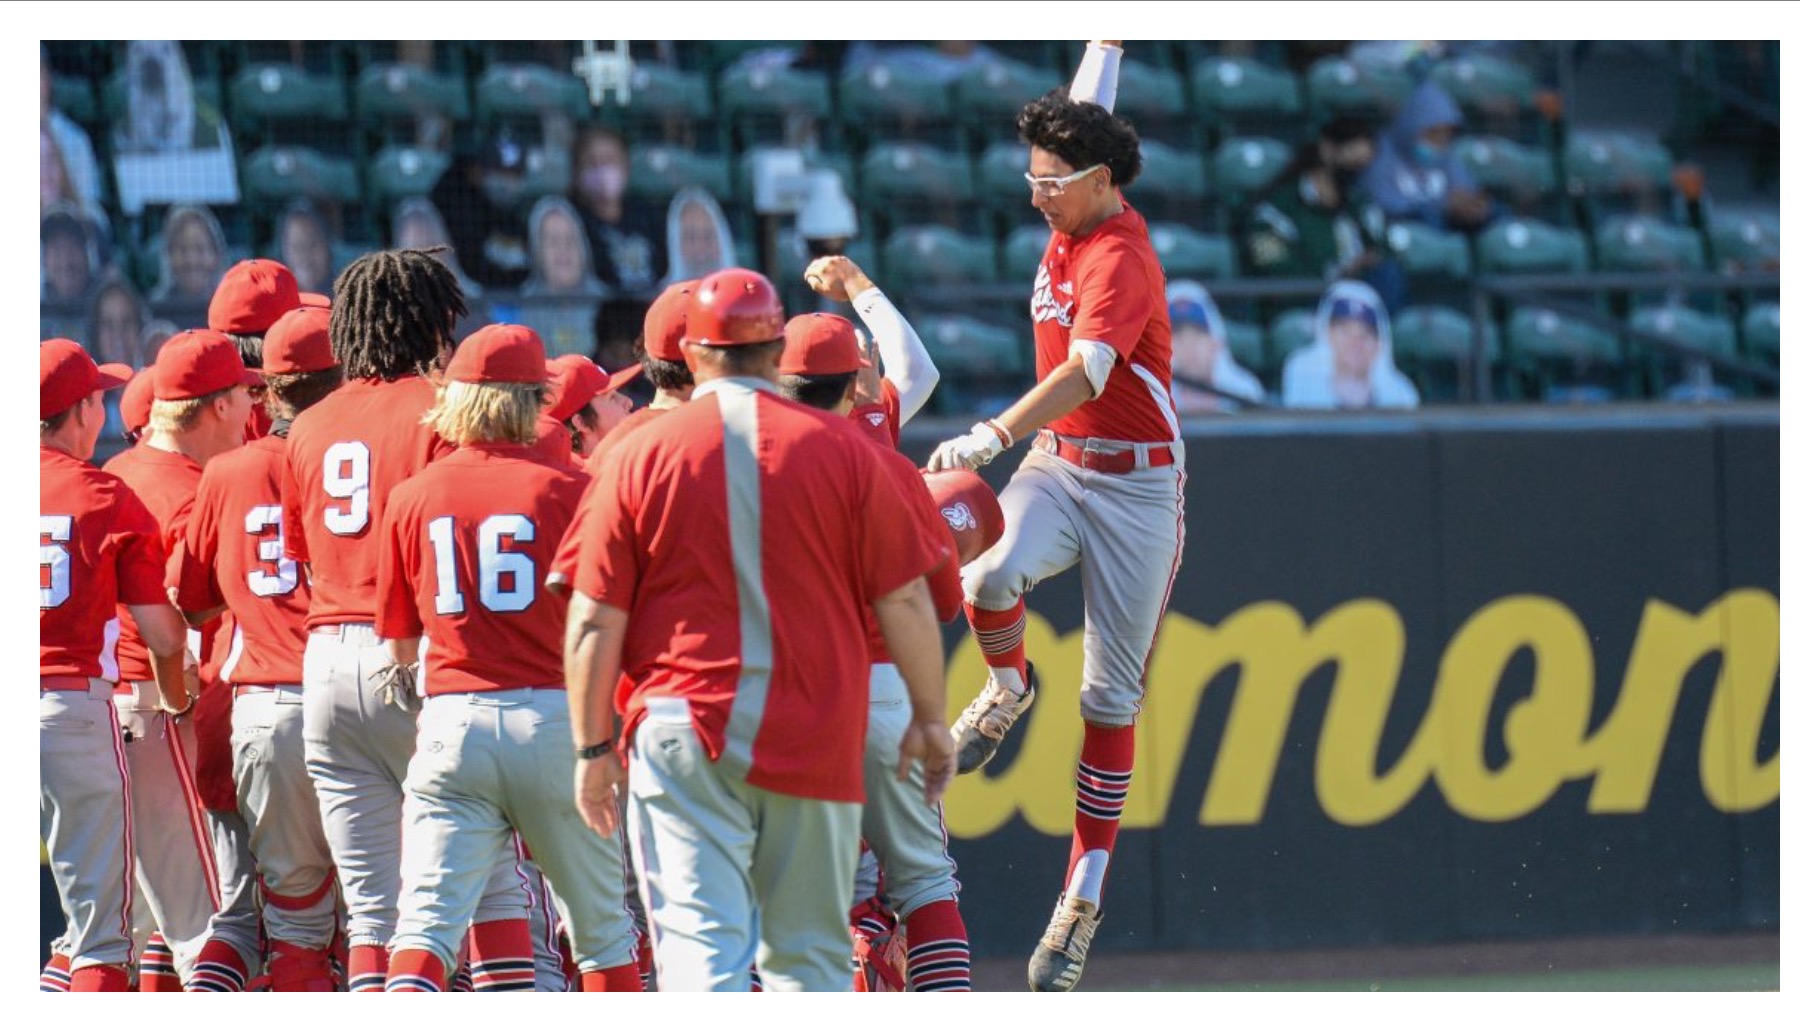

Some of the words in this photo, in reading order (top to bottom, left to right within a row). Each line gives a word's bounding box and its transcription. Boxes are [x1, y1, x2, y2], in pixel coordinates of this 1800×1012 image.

[322, 441, 370, 537] 9
[244, 503, 313, 599] 3
[428, 514, 537, 615] 16
